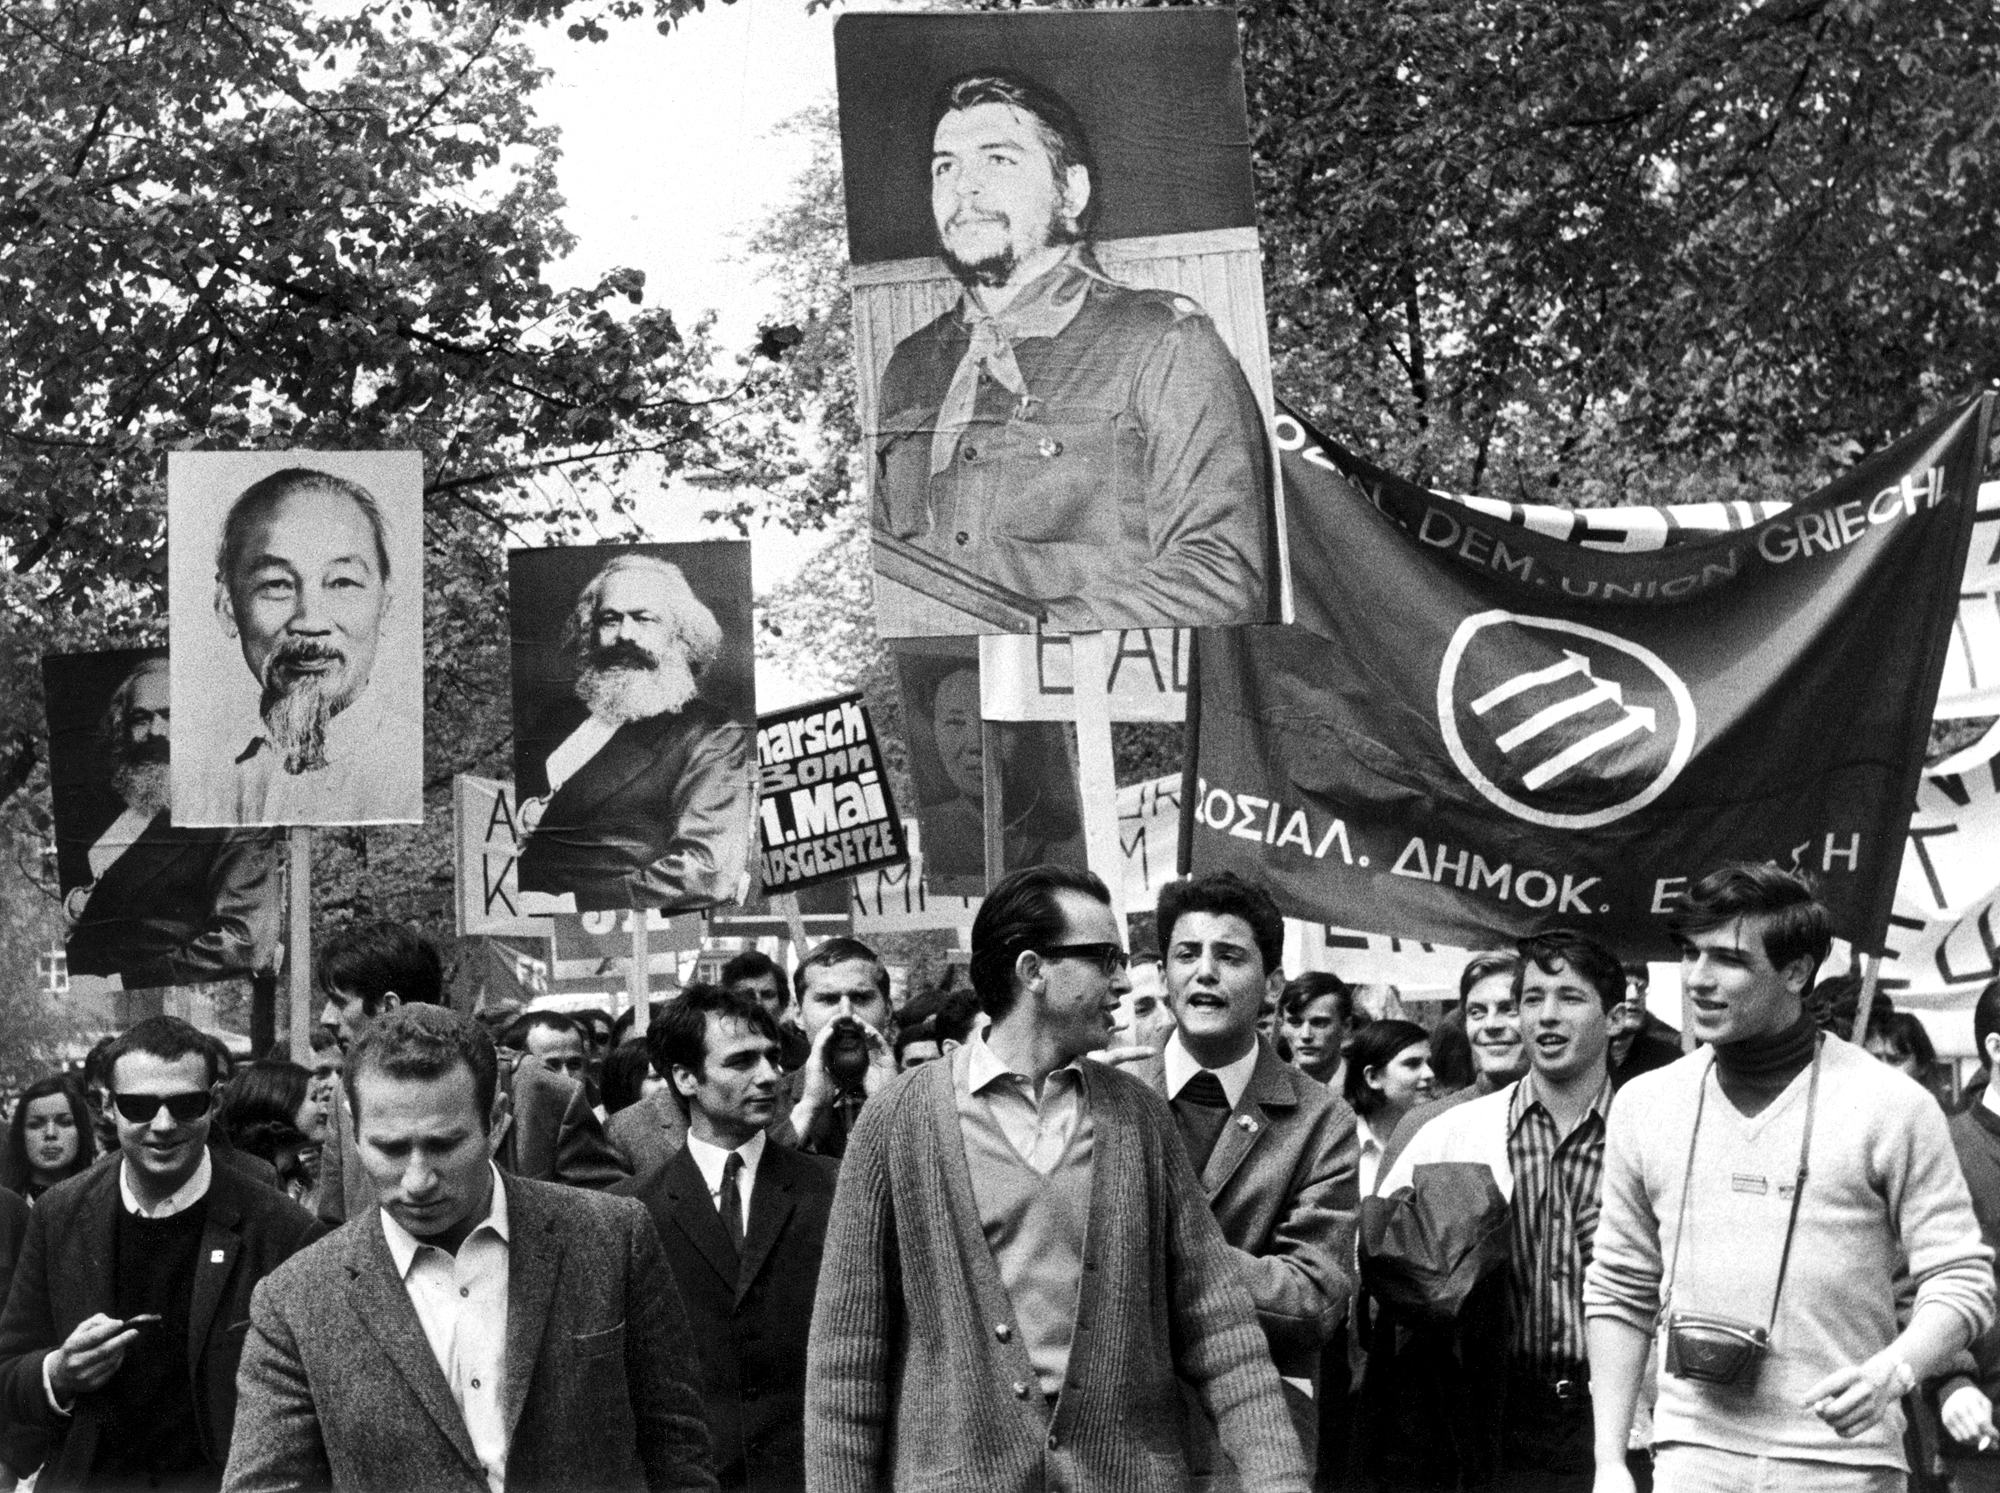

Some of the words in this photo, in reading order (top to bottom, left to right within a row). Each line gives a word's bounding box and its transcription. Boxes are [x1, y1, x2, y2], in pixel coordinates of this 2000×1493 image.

[1419, 506, 1546, 585] DEM.
[1561, 548, 1739, 599] UNION
[759, 743, 874, 796] Bonn
[1195, 777, 1371, 868] ΟΣΙΑΛ.
